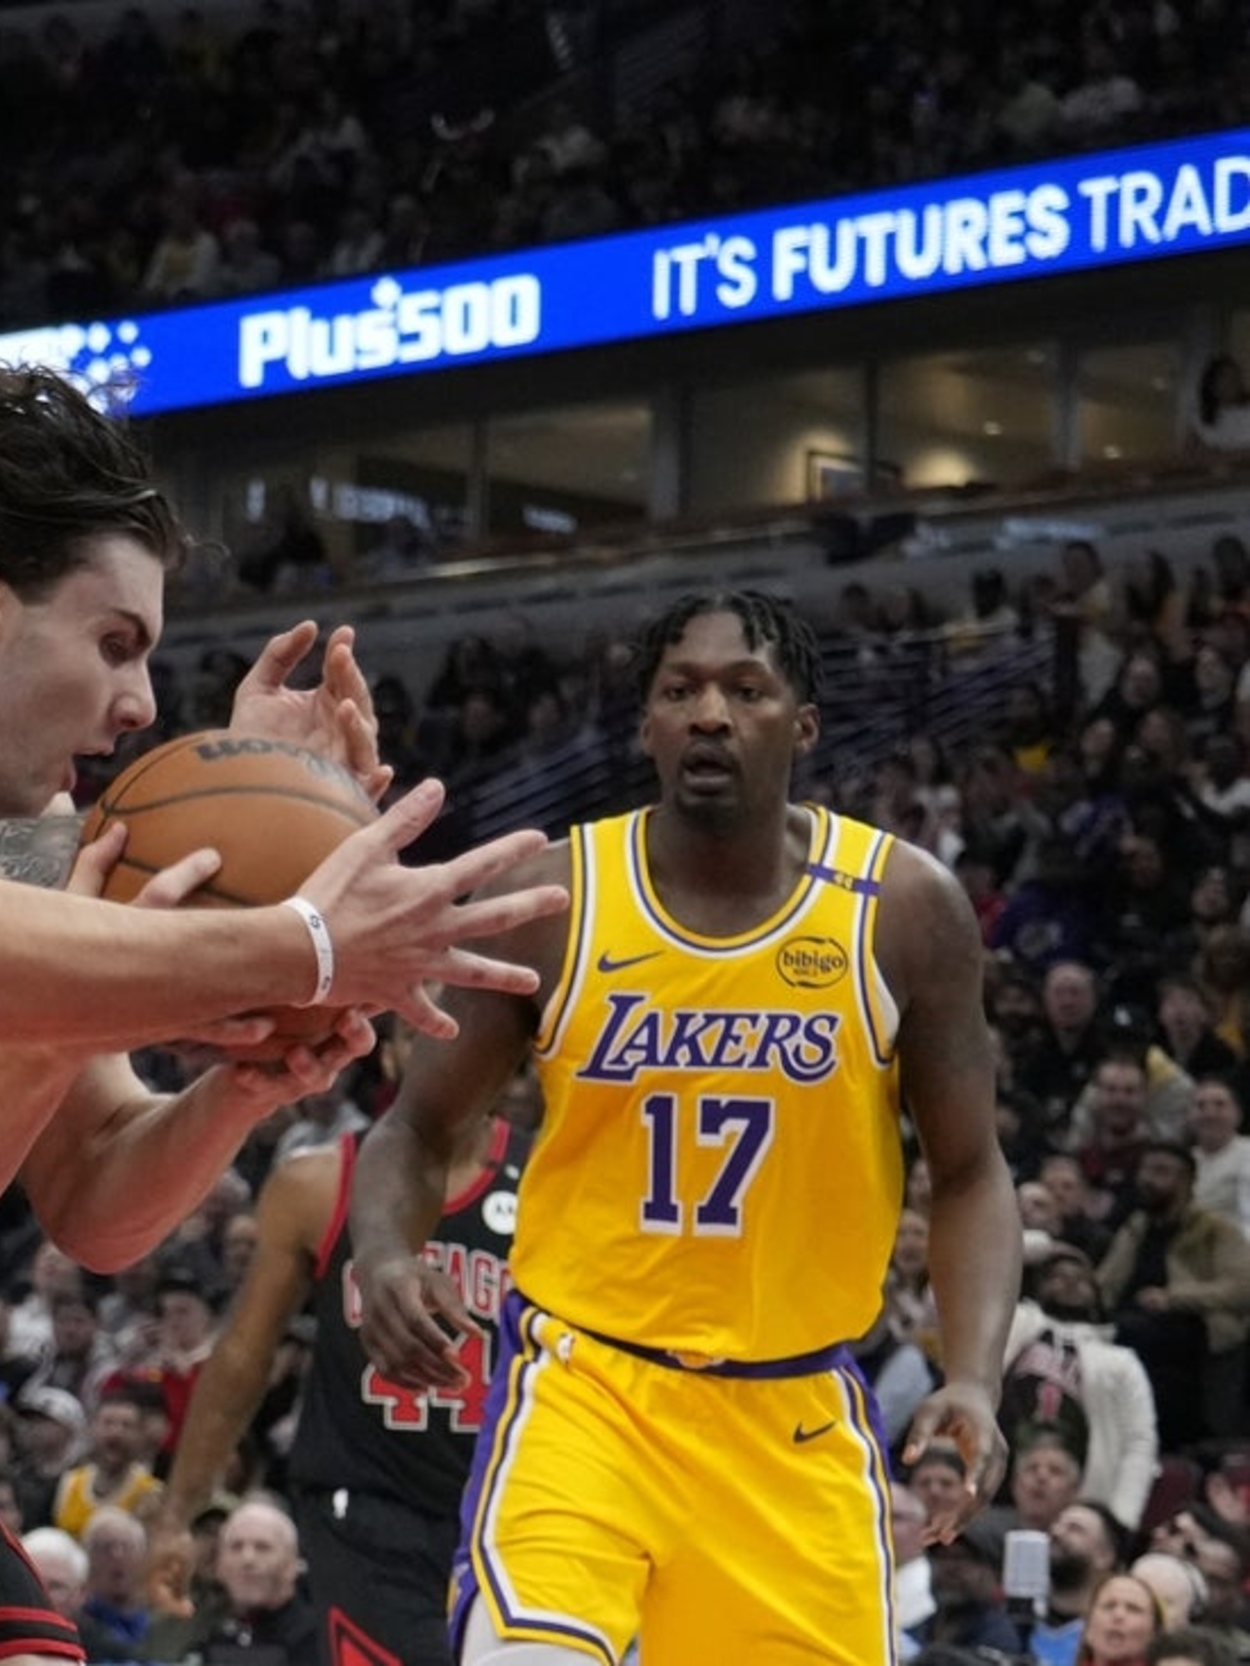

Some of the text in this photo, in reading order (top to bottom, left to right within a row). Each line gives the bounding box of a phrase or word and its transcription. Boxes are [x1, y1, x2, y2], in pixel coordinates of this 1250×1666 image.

[653, 155, 1250, 320] IT'S FUTURES TRAD
[238, 276, 541, 388] Plus500
[783, 950, 844, 973] bibigo
[575, 992, 840, 1083] LAKERS
[639, 1092, 776, 1238] 17
